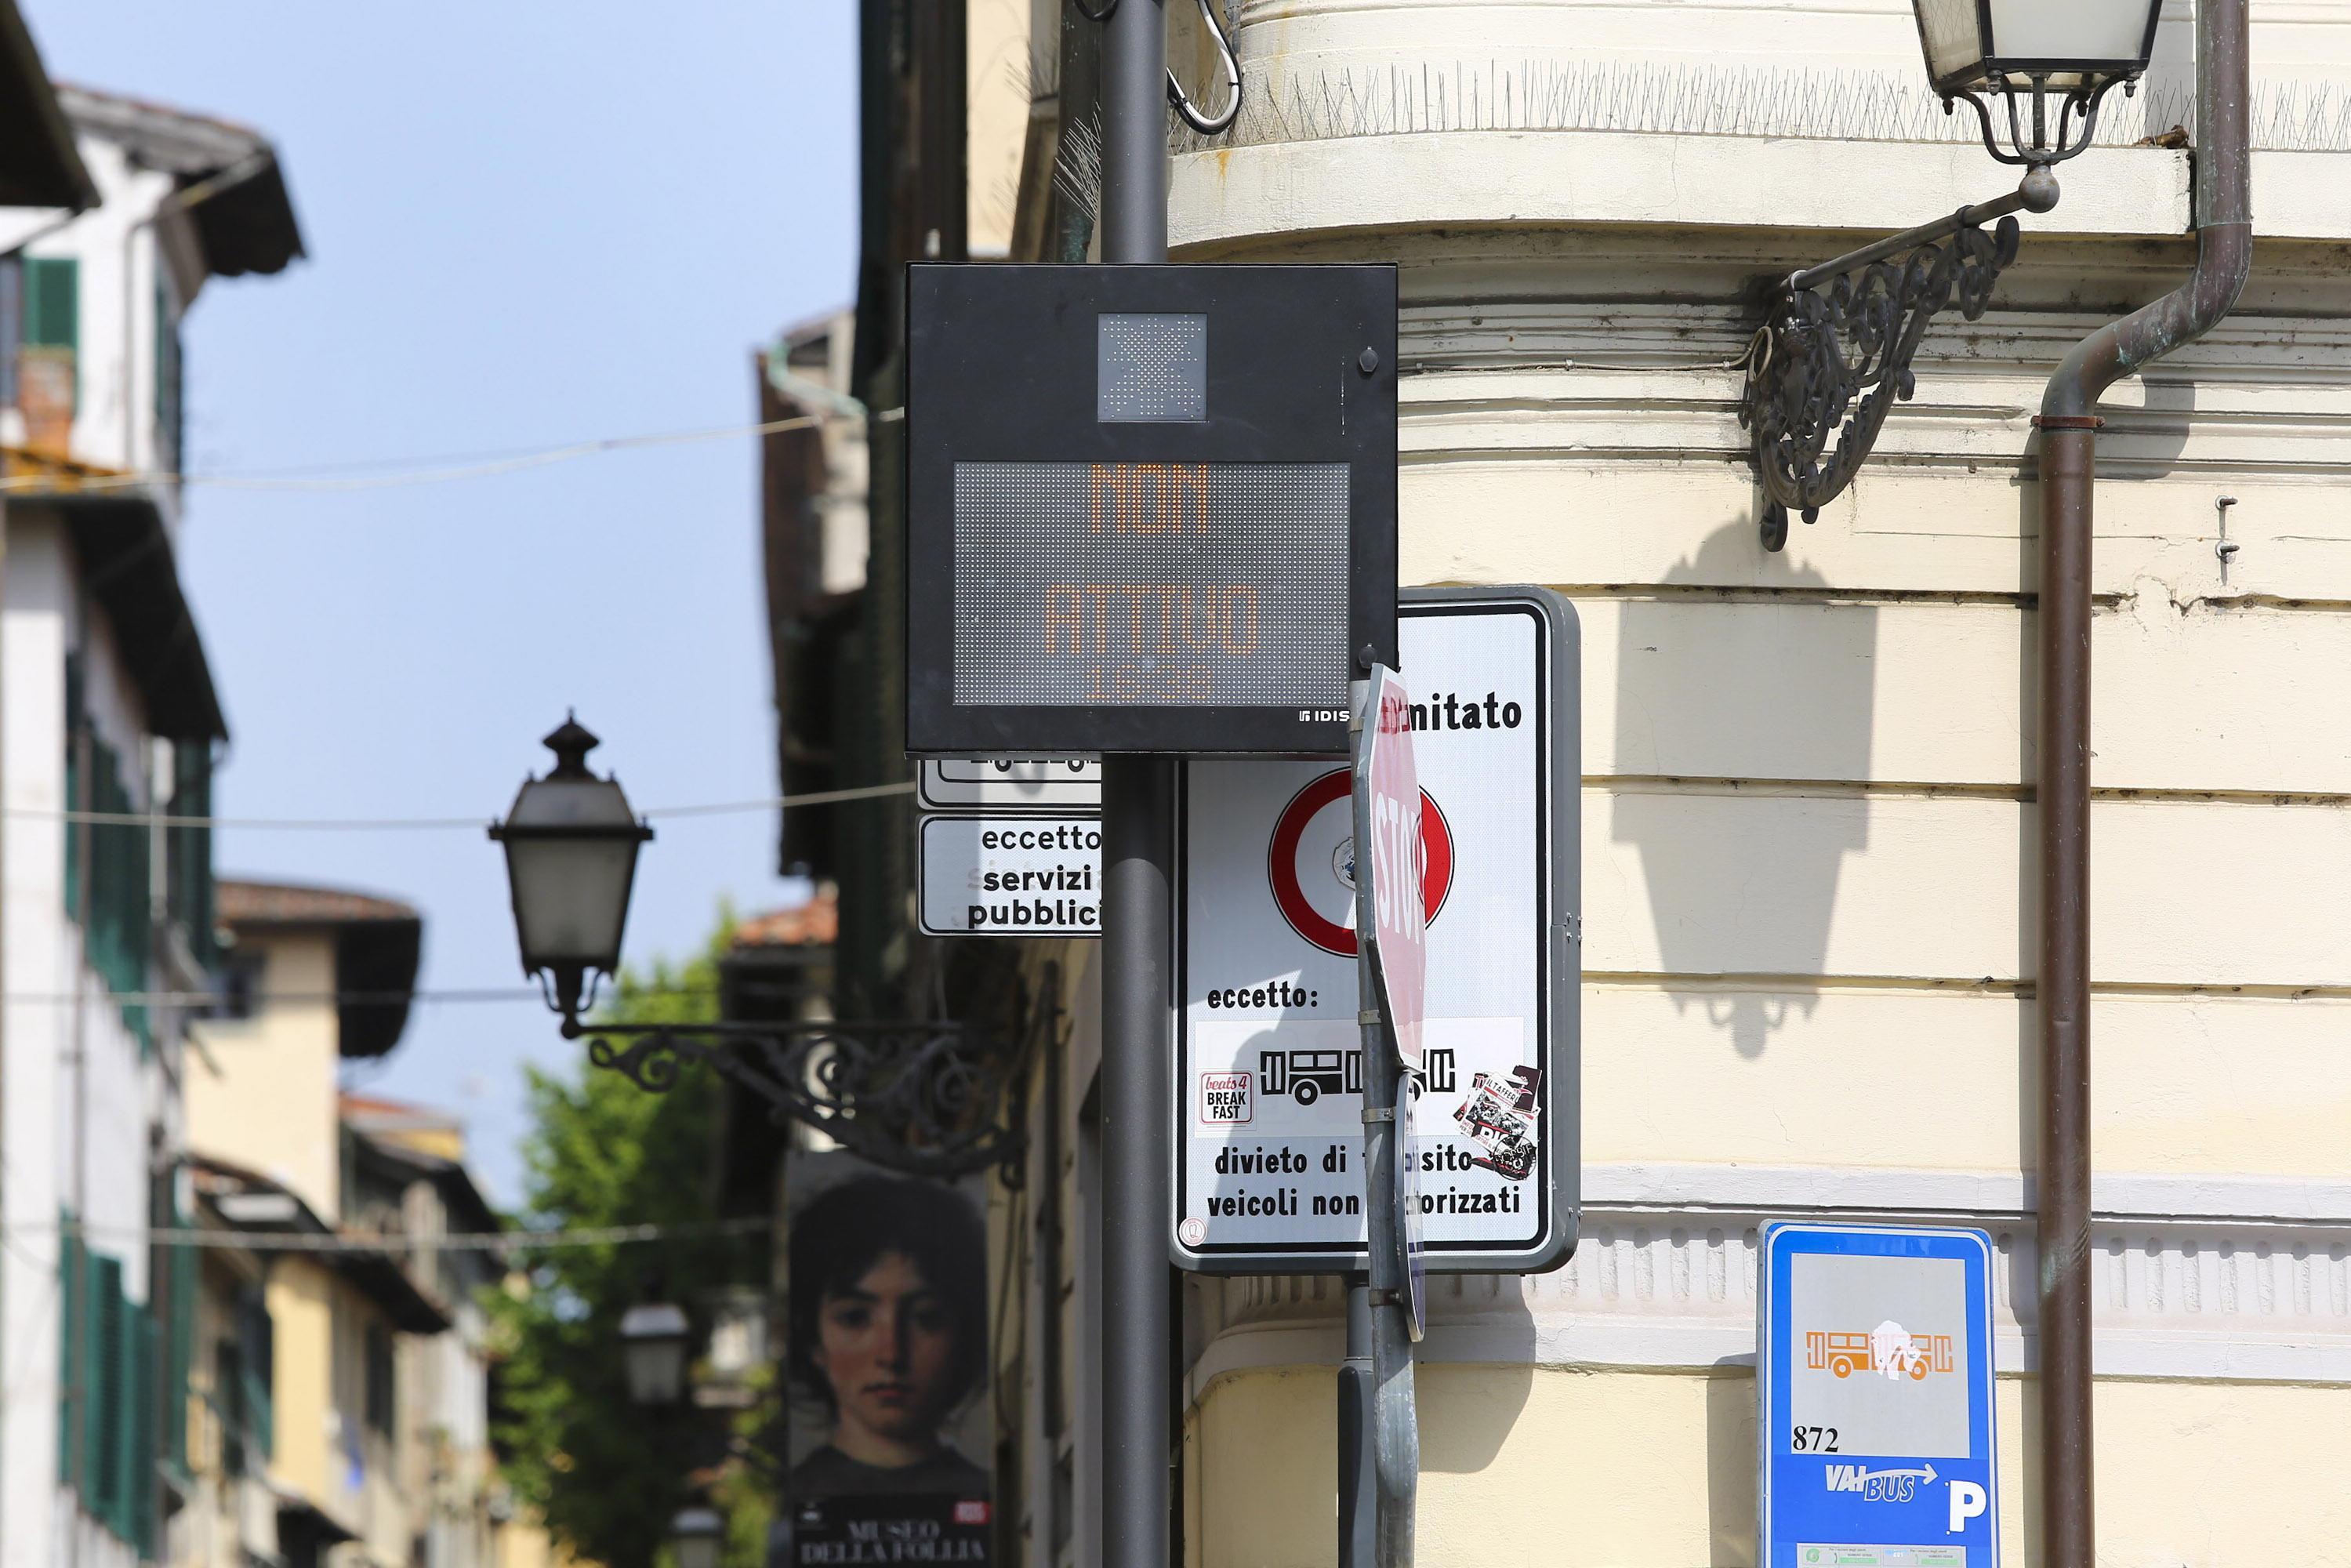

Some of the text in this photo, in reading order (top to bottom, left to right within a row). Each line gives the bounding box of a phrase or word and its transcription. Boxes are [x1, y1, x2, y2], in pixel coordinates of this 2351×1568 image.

[1090, 463, 1209, 534] NON
[1044, 584, 1257, 656] ATTIVO
[1085, 664, 1212, 699] 16:38
[1315, 710, 1350, 721] IDIS
[981, 826, 1101, 850] eccetto
[982, 864, 1091, 891] servizi
[1206, 981, 1319, 1009] eccetto:
[1205, 1076, 1247, 1090] beats 4
[1207, 1091, 1246, 1105] BREAK
[1213, 1105, 1240, 1119] FAST
[1214, 1145, 1308, 1175] divieto
[1322, 1145, 1347, 1174] di
[1207, 1186, 1520, 1217] veicoli non orizzati
[1792, 1425, 1839, 1453] 872
[1949, 1479, 1988, 1537] P
